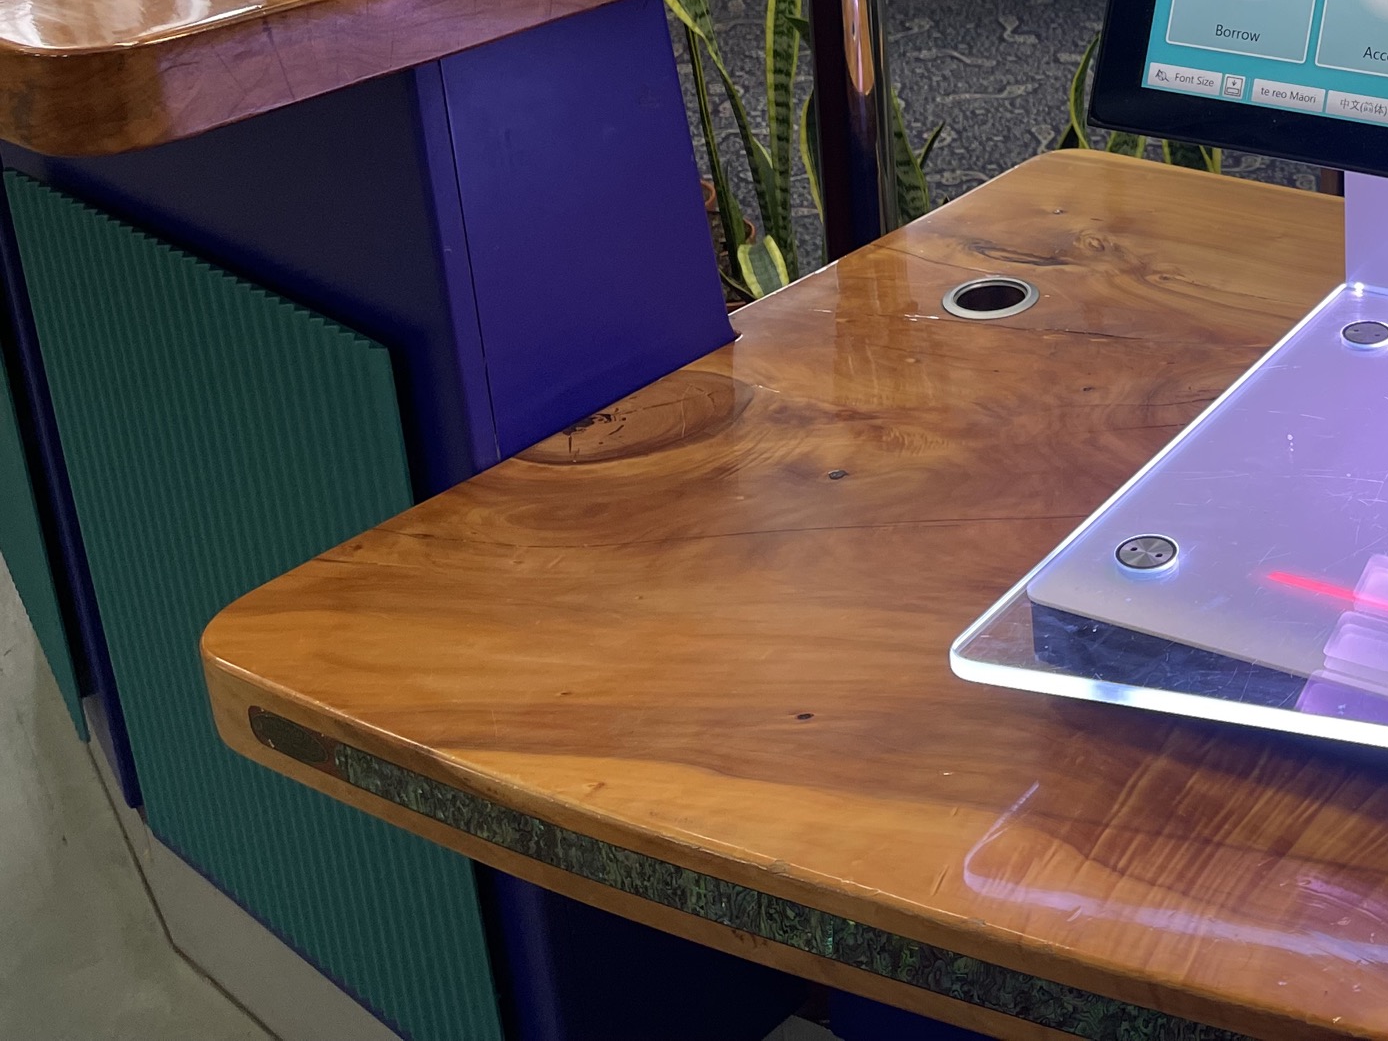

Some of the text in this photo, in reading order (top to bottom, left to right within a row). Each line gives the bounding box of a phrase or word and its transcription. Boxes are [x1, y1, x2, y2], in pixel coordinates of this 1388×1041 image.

[1215, 23, 1260, 44] Borrow
[1174, 73, 1215, 88] Font Size
[1260, 86, 1270, 97] te
[1272, 90, 1287, 100] reo
